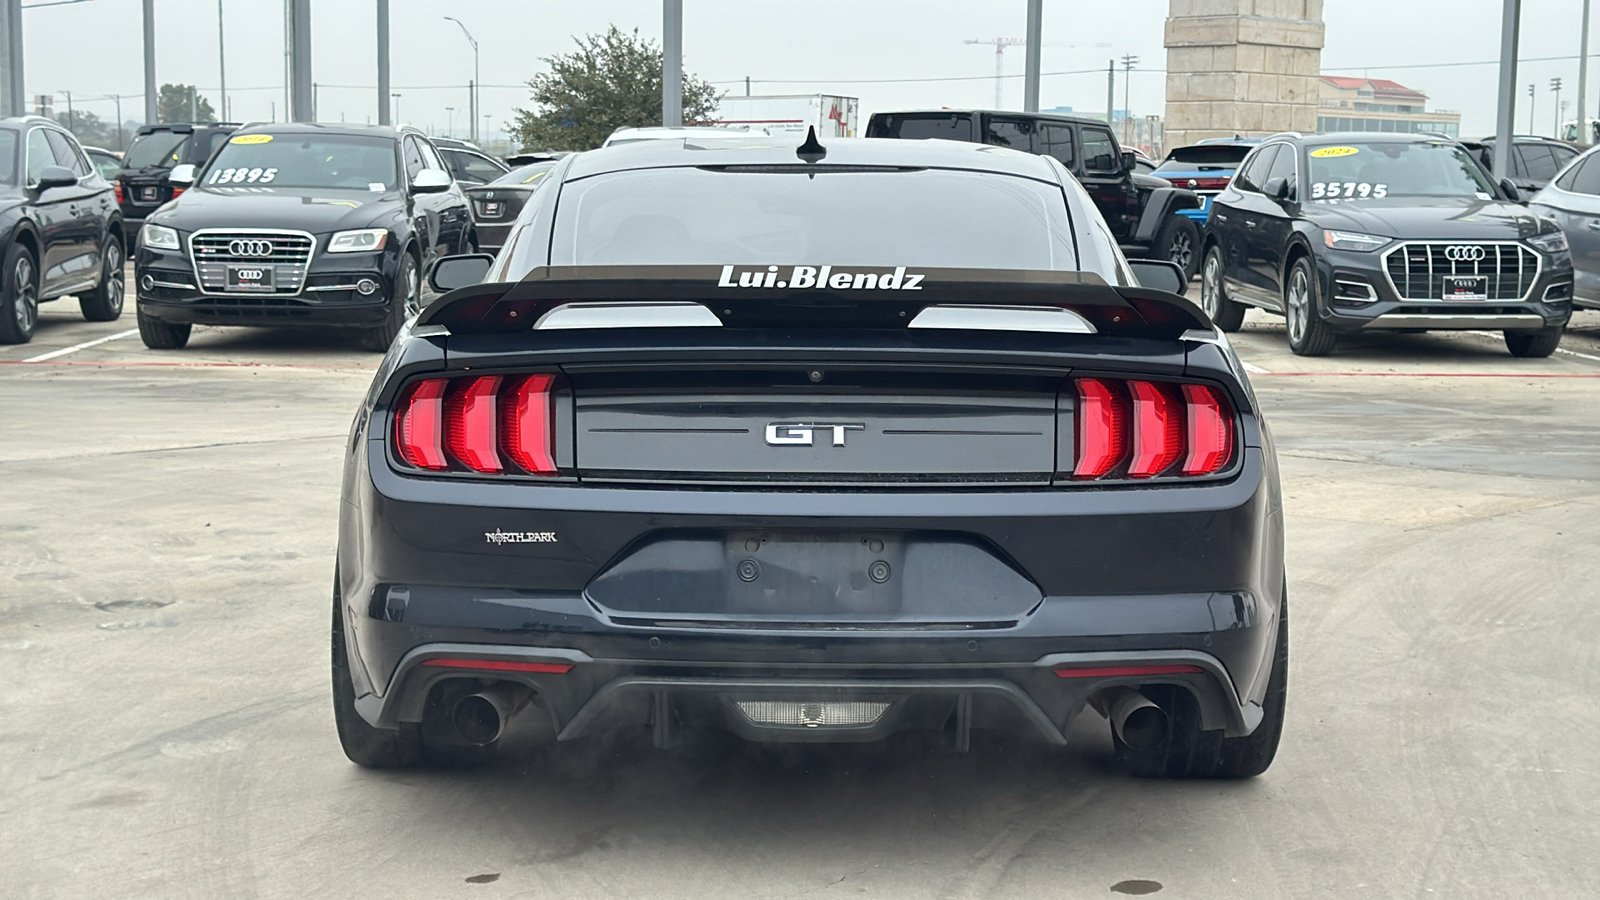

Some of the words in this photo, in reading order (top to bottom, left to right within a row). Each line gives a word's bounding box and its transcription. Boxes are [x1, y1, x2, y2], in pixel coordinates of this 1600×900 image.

[209, 168, 278, 184] 13895
[1312, 182, 1388, 198] 35795
[718, 265, 925, 290] Lui.Blendz
[765, 421, 866, 447] GT
